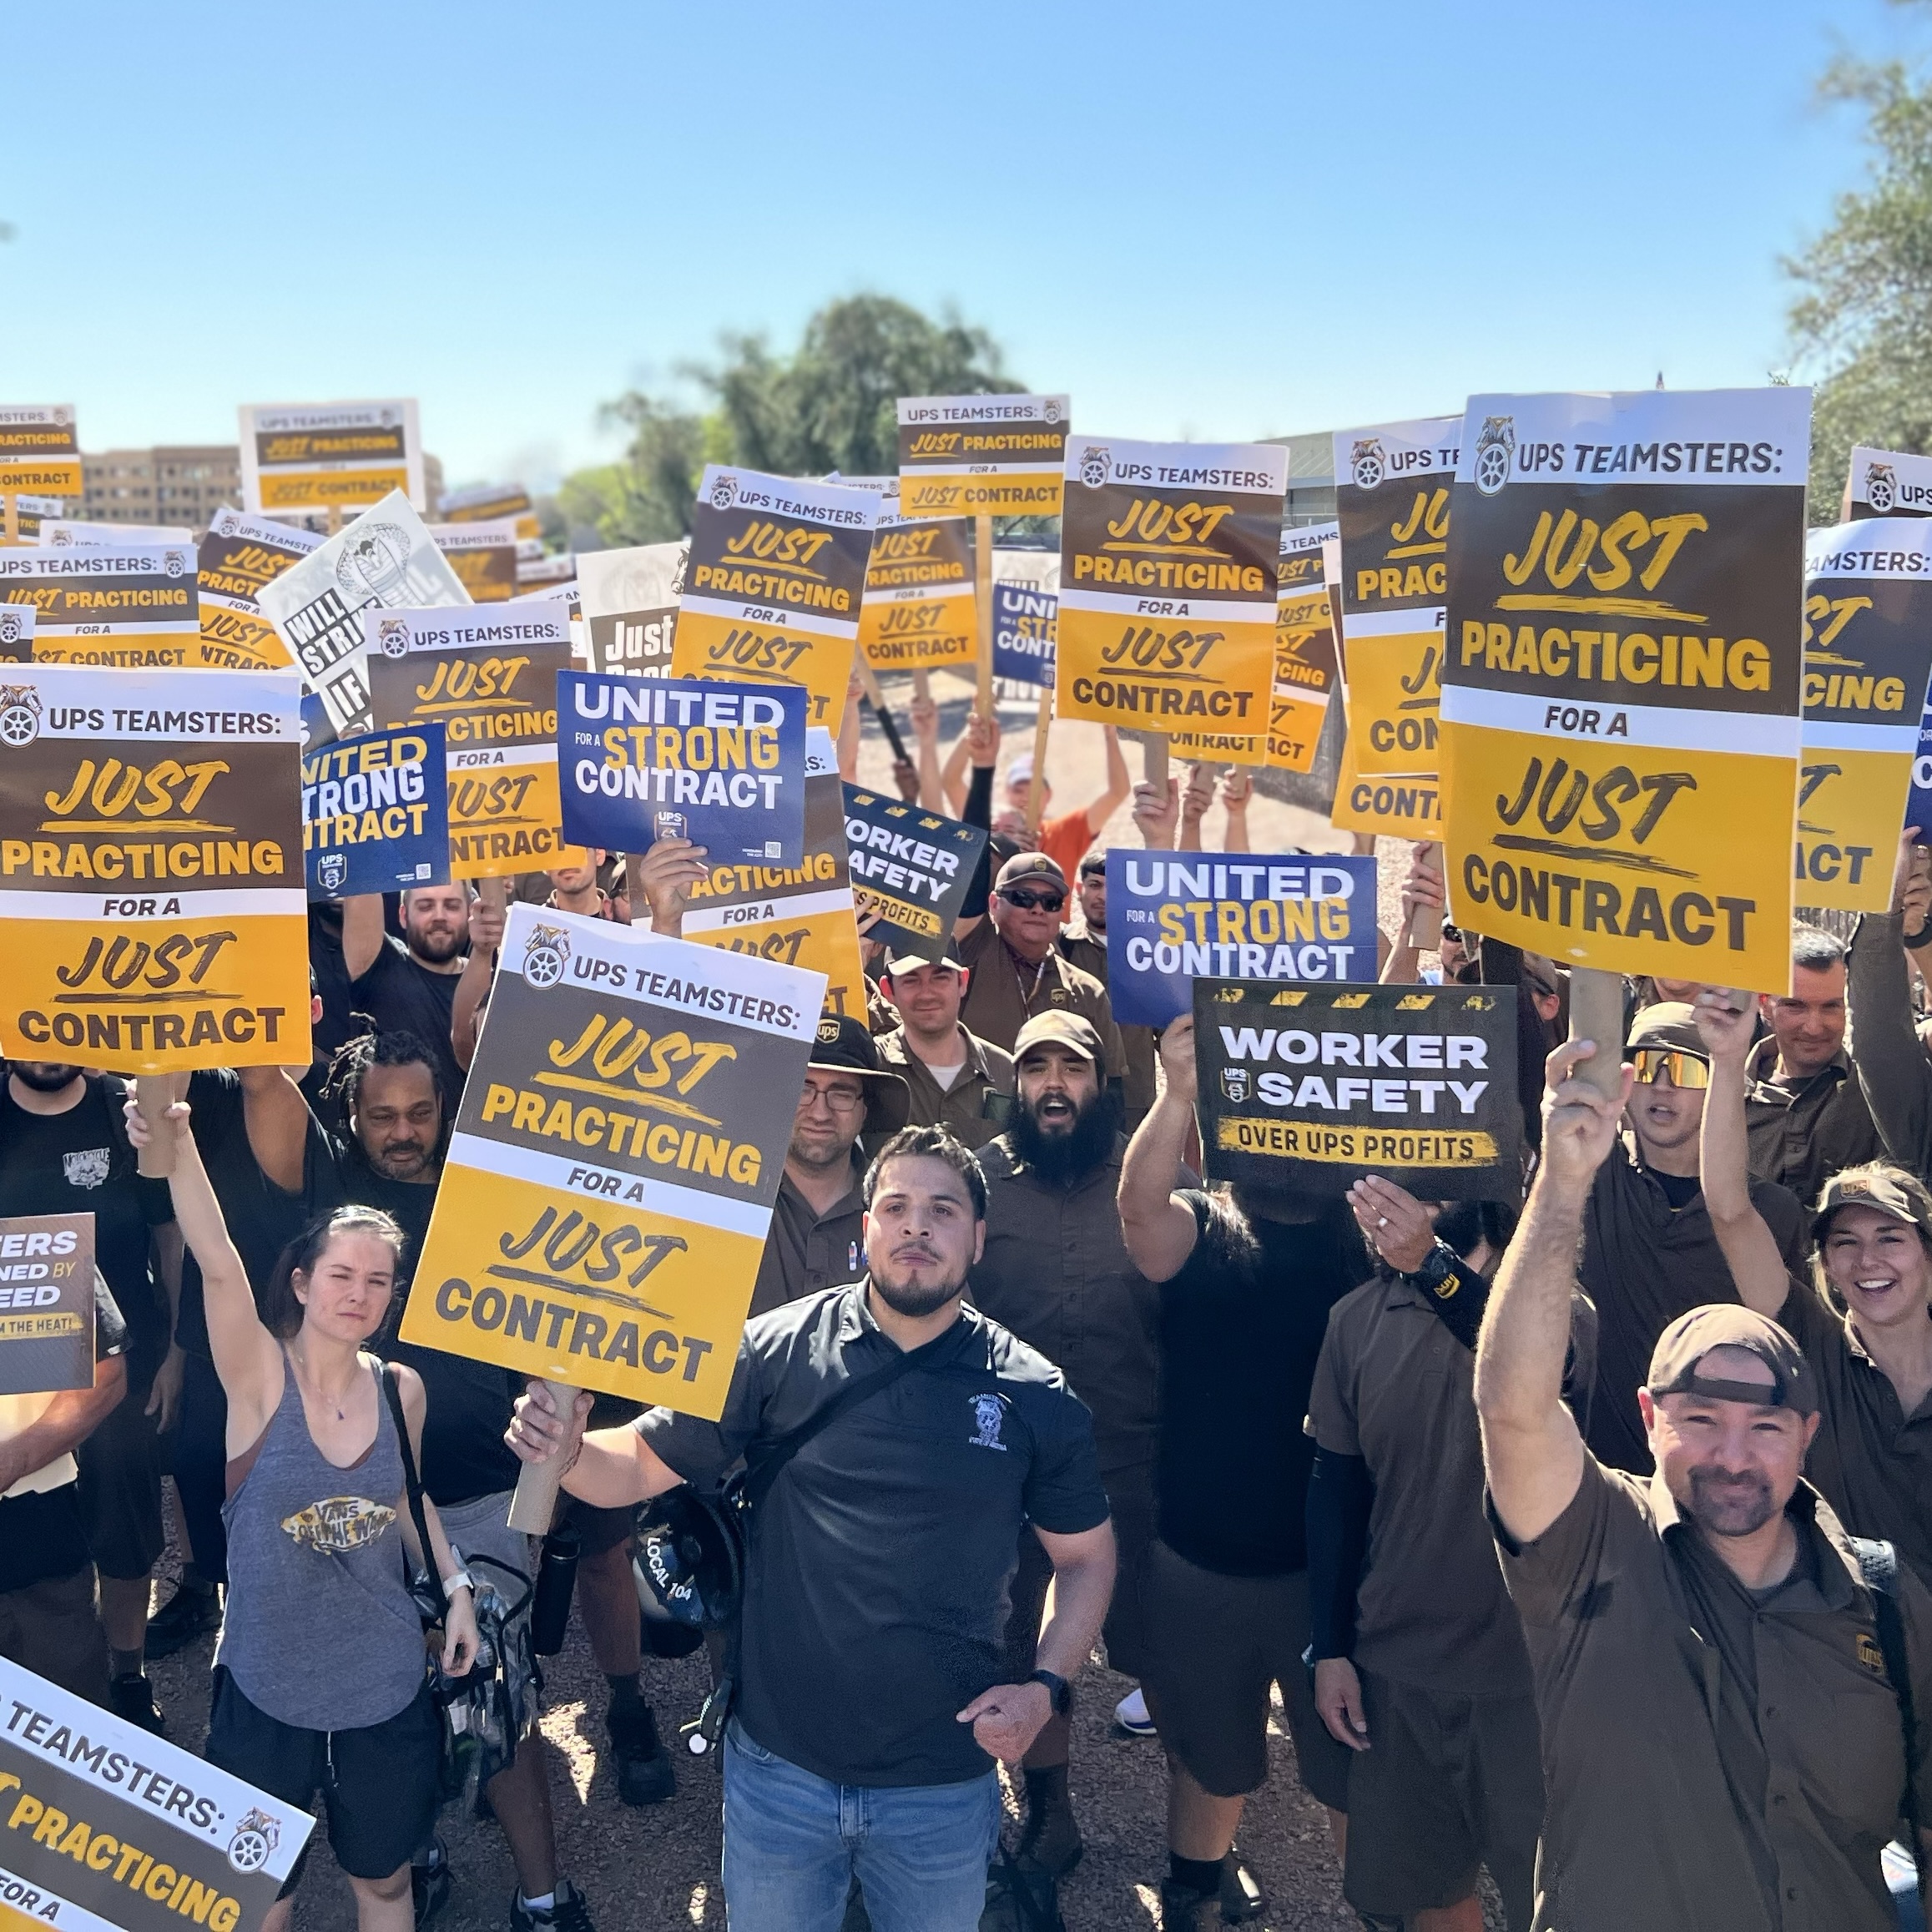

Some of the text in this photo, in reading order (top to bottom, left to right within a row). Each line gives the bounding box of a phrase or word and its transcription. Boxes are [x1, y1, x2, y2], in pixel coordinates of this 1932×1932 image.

[908, 406, 1038, 421] UPS TEAMSTERS:
[0, 432, 71, 446] RACTICING
[910, 432, 1062, 453] JUST PRACTICING
[1115, 464, 1274, 489] UPS TEAMSTERS:
[1391, 449, 1431, 471] UPS
[1519, 443, 1783, 475] UPS TEAMSTERS:
[739, 491, 866, 526] UPS TEAMSTERS:
[911, 486, 1058, 505] JUST CONTRACT
[1107, 499, 1234, 543] JUST
[240, 526, 318, 553] UPS TEAMSTE
[727, 521, 833, 564] JUST
[871, 529, 940, 560] JUST
[1290, 532, 1339, 548] TEAMS
[1503, 509, 1708, 591] JUST
[37, 557, 157, 573] TEAMSTERS:
[867, 562, 964, 586] RACTICING
[1074, 554, 1264, 593] PRACTICING
[1278, 558, 1311, 577] UST
[1805, 552, 1930, 573] AMSTERS:
[65, 588, 188, 608] PRACTICING
[197, 570, 264, 597] PRACT
[694, 565, 850, 612] PRACTICING
[228, 600, 260, 616] FOR A
[286, 593, 346, 645] WILL
[743, 607, 787, 624] FOR A
[879, 603, 946, 632] JUST
[1002, 591, 1056, 619] UNI
[1137, 601, 1189, 616] FOR A
[1805, 594, 1874, 648] ST
[75, 625, 111, 634] FOR A
[200, 613, 276, 646] JUST
[414, 624, 560, 646] UPS TEAMSTERS:
[605, 615, 673, 662] Just
[997, 631, 1055, 659] CONT
[1102, 627, 1225, 668] JUST
[1276, 632, 1315, 653] ST
[70, 648, 185, 667] CONTRACT
[709, 629, 813, 671] JUST
[867, 637, 968, 659] CONTRACT
[1460, 620, 1772, 692] PRACTICING
[330, 673, 366, 718] IF
[417, 656, 530, 701] JUST
[575, 684, 784, 729] UNITED
[1072, 678, 1253, 718] CONTRACT
[49, 709, 105, 732] UPS
[113, 711, 281, 734] TEAMSTERS:
[1545, 706, 1628, 737] FOR A
[301, 735, 427, 786] NITED
[457, 751, 504, 767] FOR A
[575, 726, 780, 770] FOR A STRONG
[44, 759, 230, 818] JUST
[302, 761, 425, 827] TRONG
[575, 759, 783, 810] CONTRACT
[1350, 784, 1441, 821] CONT
[1498, 757, 1697, 845] JUST
[658, 811, 682, 822] UPS
[2, 840, 285, 880] PRACTICING
[321, 854, 343, 865] UPS
[451, 825, 566, 862] NTRACT
[845, 815, 959, 877] ORKER
[849, 850, 951, 902] AFETY
[1125, 861, 1354, 901] UNITED
[103, 897, 182, 917] FOR A
[723, 904, 774, 924] FOR A
[1463, 854, 1757, 952] CONTRACT
[1127, 897, 1350, 946] FOR A STRONG
[57, 931, 238, 990] JUST
[1126, 937, 1354, 981] CONTRACT
[573, 956, 627, 987] UPS
[635, 969, 801, 1031] TEAMSTERS:
[19, 1007, 285, 1052] CONTRACT
[818, 1026, 838, 1040] ups
[548, 1014, 737, 1096] JUST
[1218, 1026, 1488, 1070] WORKER
[1223, 1067, 1247, 1078] UPS
[1257, 1072, 1488, 1115] SAFETY
[481, 1083, 762, 1187] PRACTICING
[1238, 1123, 1473, 1161] OVER UPS PROFITS
[567, 1169, 645, 1203] FOR A
[0, 1231, 78, 1258] ERS
[500, 1206, 688, 1289] JUST
[53, 1261, 77, 1279] BY
[9, 1318, 73, 1333] THE HEAT!
[435, 1278, 713, 1383] CONTRACT
[647, 1537, 692, 1602] LOCAL 104
[6, 1700, 225, 1834] TEAMSTERS:
[8, 1793, 240, 1932] PRACTICING
[40, 1900, 60, 1922] A
